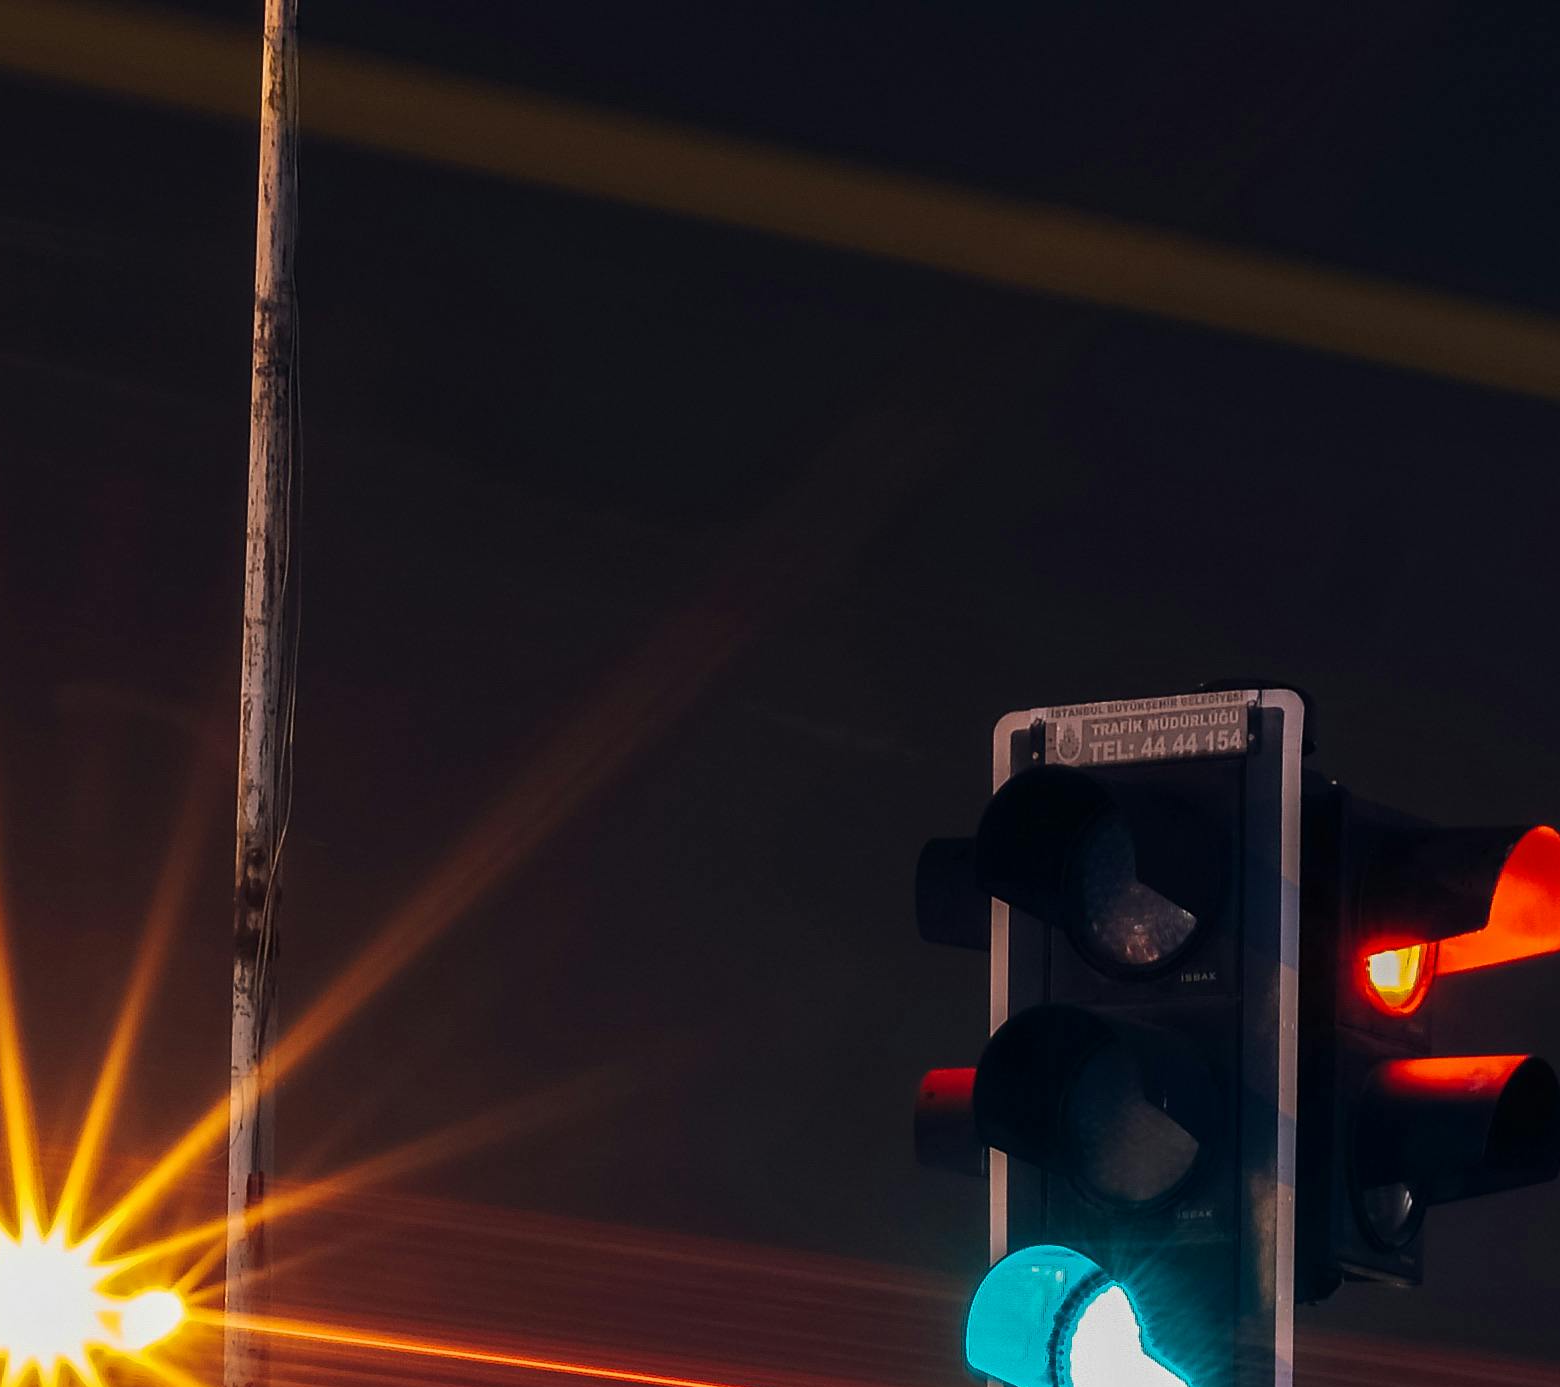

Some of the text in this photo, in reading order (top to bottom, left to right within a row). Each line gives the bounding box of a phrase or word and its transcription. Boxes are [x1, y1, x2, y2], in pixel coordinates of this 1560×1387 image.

[1051, 704, 1103, 718] İSTANBUL
[1091, 707, 1239, 736] TRAFİK MÜDÜRLÜĞÜ
[1089, 728, 1242, 762] TEL: 44 44 154
